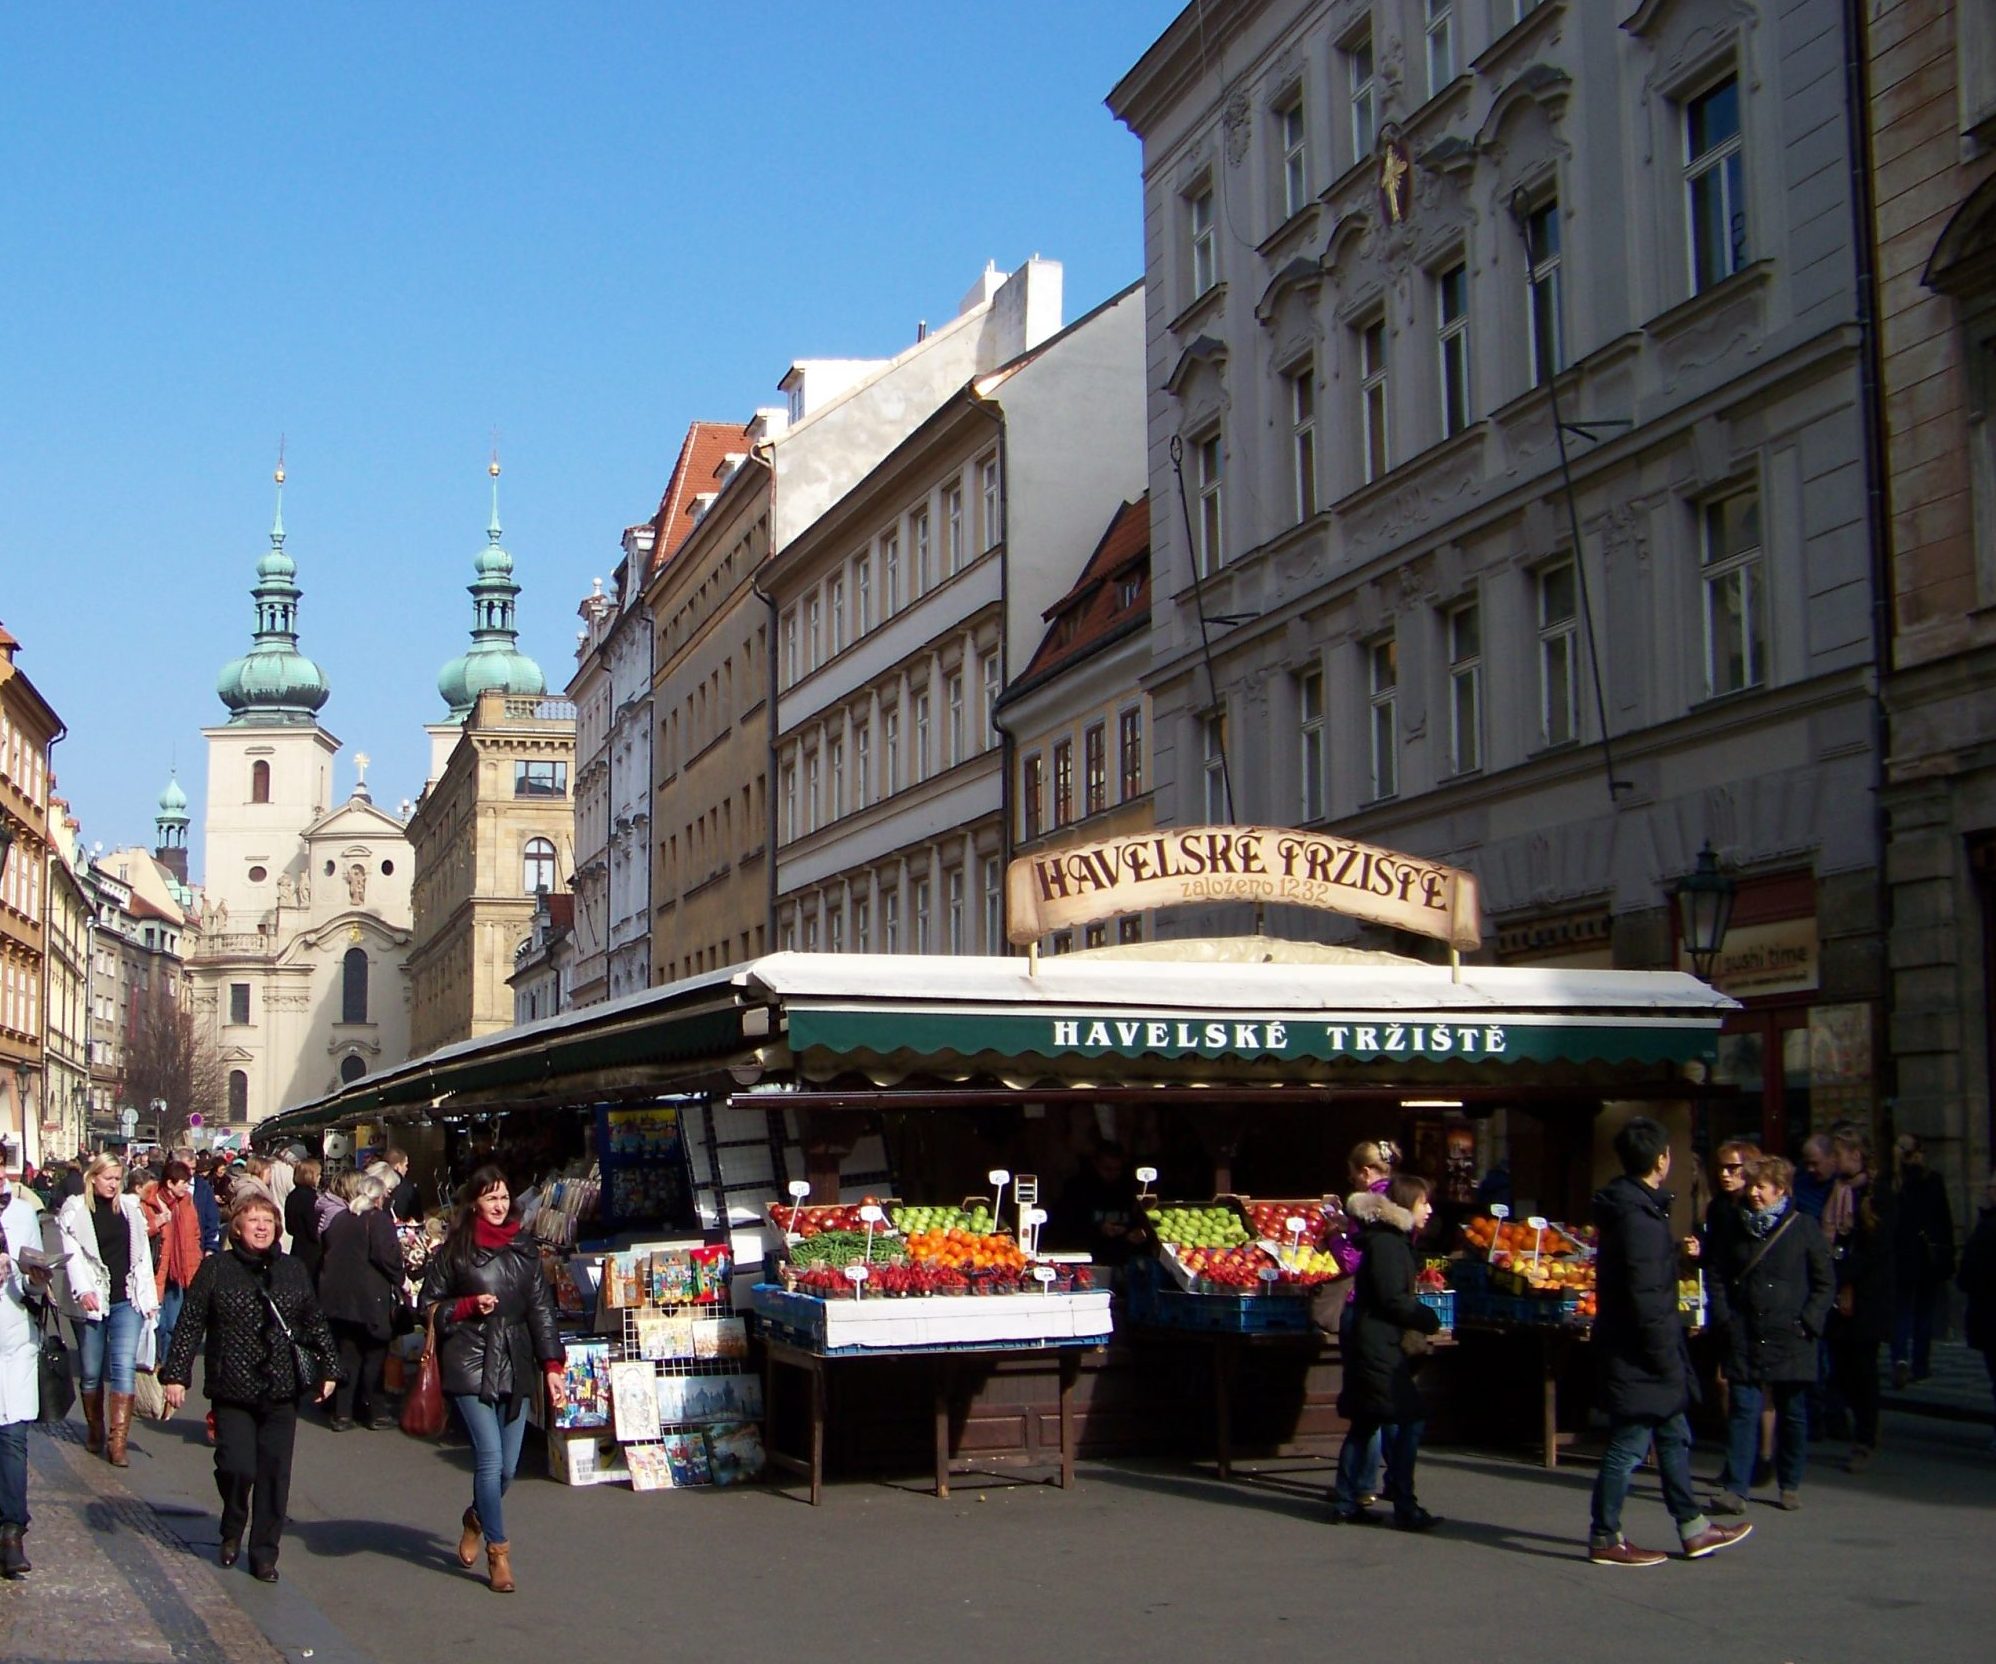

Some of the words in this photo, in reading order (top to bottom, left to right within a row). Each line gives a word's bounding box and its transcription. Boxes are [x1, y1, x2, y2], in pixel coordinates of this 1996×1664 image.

[1036, 829, 1268, 901] HAVELSKÉ
[1180, 876, 1274, 898] založeno
[1279, 876, 1329, 904] 1232
[1767, 943, 1808, 967] time
[1053, 1021, 1288, 1050] HAVELSKÉ
[1326, 1023, 1508, 1053] TRŽIŠTĚ
